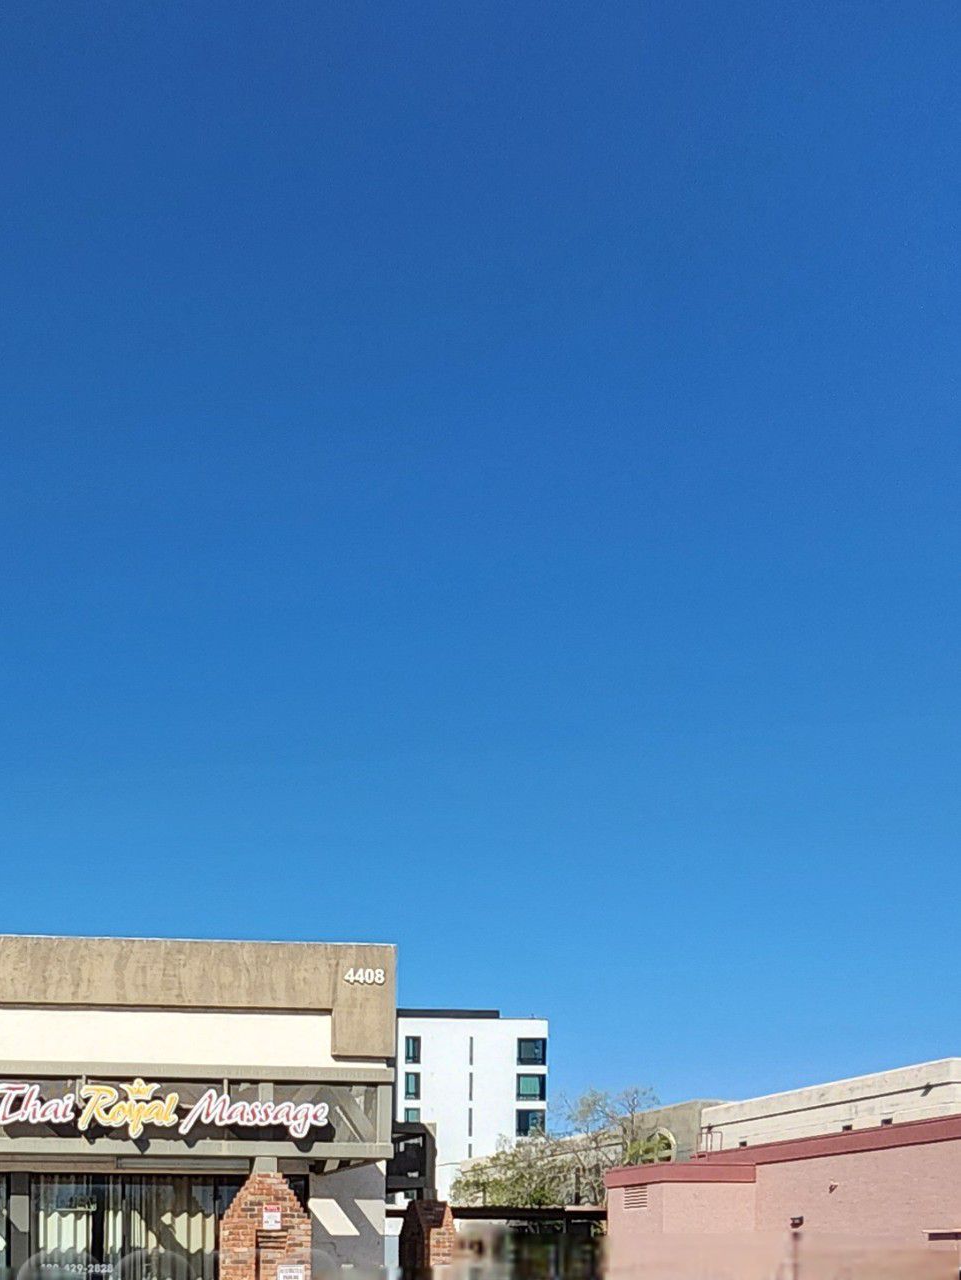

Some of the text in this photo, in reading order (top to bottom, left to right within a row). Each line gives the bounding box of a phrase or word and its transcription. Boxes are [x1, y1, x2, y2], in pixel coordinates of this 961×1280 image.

[344, 968, 385, 985] 4408
[77, 1083, 179, 1138] Royal
[178, 1088, 330, 1140] Massage
